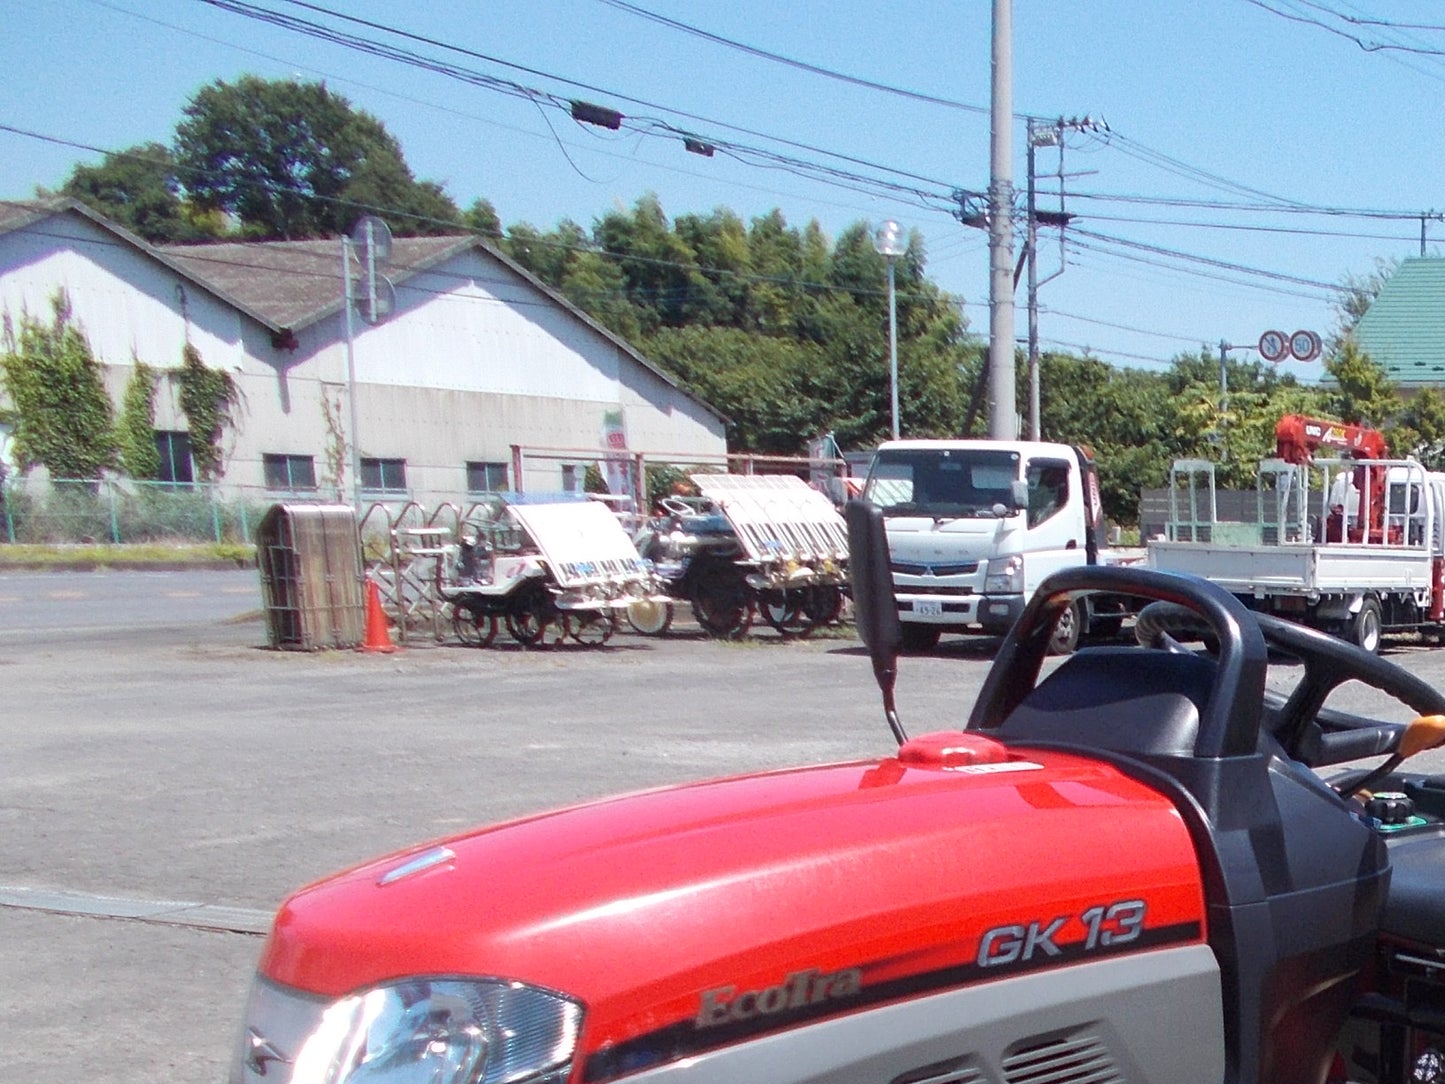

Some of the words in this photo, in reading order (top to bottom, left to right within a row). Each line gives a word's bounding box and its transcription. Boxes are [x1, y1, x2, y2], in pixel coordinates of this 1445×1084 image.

[1294, 338, 1310, 353] 50
[976, 917, 1070, 968] GK
[1081, 898, 1148, 950] 13
[696, 967, 861, 1029] EcoTra
